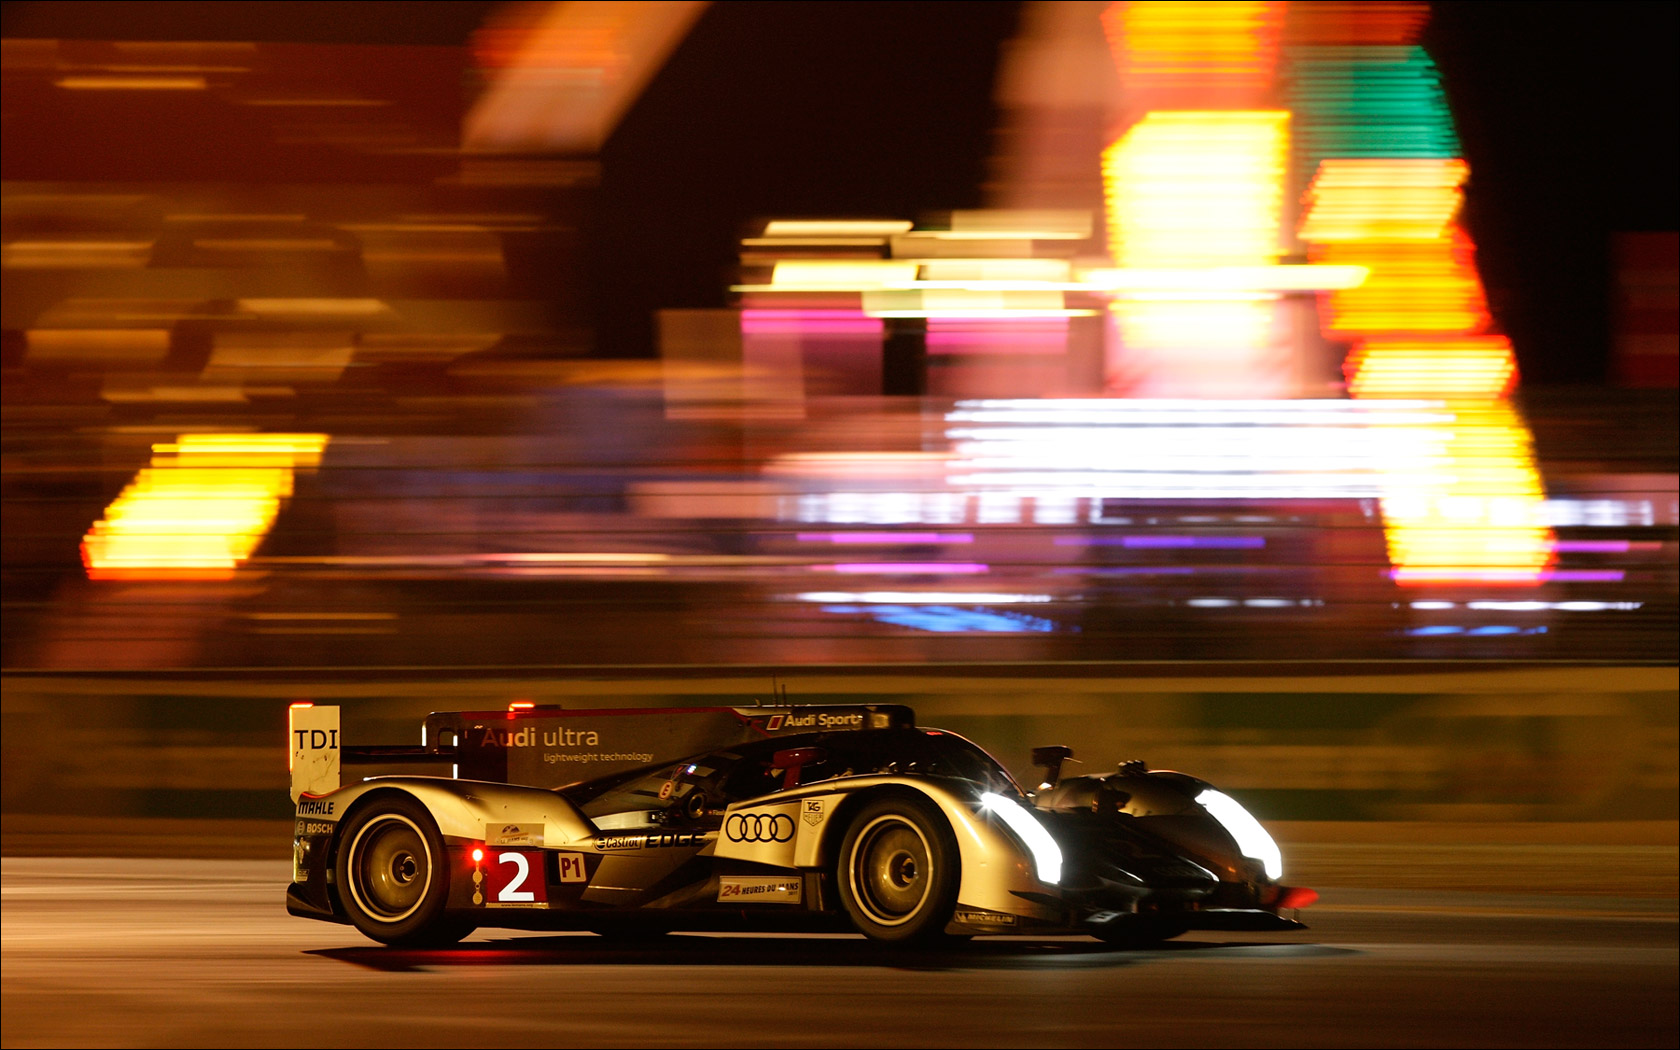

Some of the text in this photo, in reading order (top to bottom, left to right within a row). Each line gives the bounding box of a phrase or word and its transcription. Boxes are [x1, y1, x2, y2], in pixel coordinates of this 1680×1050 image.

[784, 713, 860, 728] Audi Sport
[294, 729, 338, 750] TDI
[480, 727, 599, 748] Audi ultra
[543, 752, 654, 764] lightweight technology
[298, 801, 335, 815] MAHLE
[306, 823, 333, 834] BOSCH
[606, 836, 638, 849] Castrol
[645, 833, 707, 849] EDGE
[561, 857, 581, 878] P1
[498, 852, 535, 902] 2
[721, 884, 741, 897] 24
[741, 885, 766, 895] HEURES
[766, 884, 776, 893] DU
[967, 914, 1014, 923] MICHELIN
